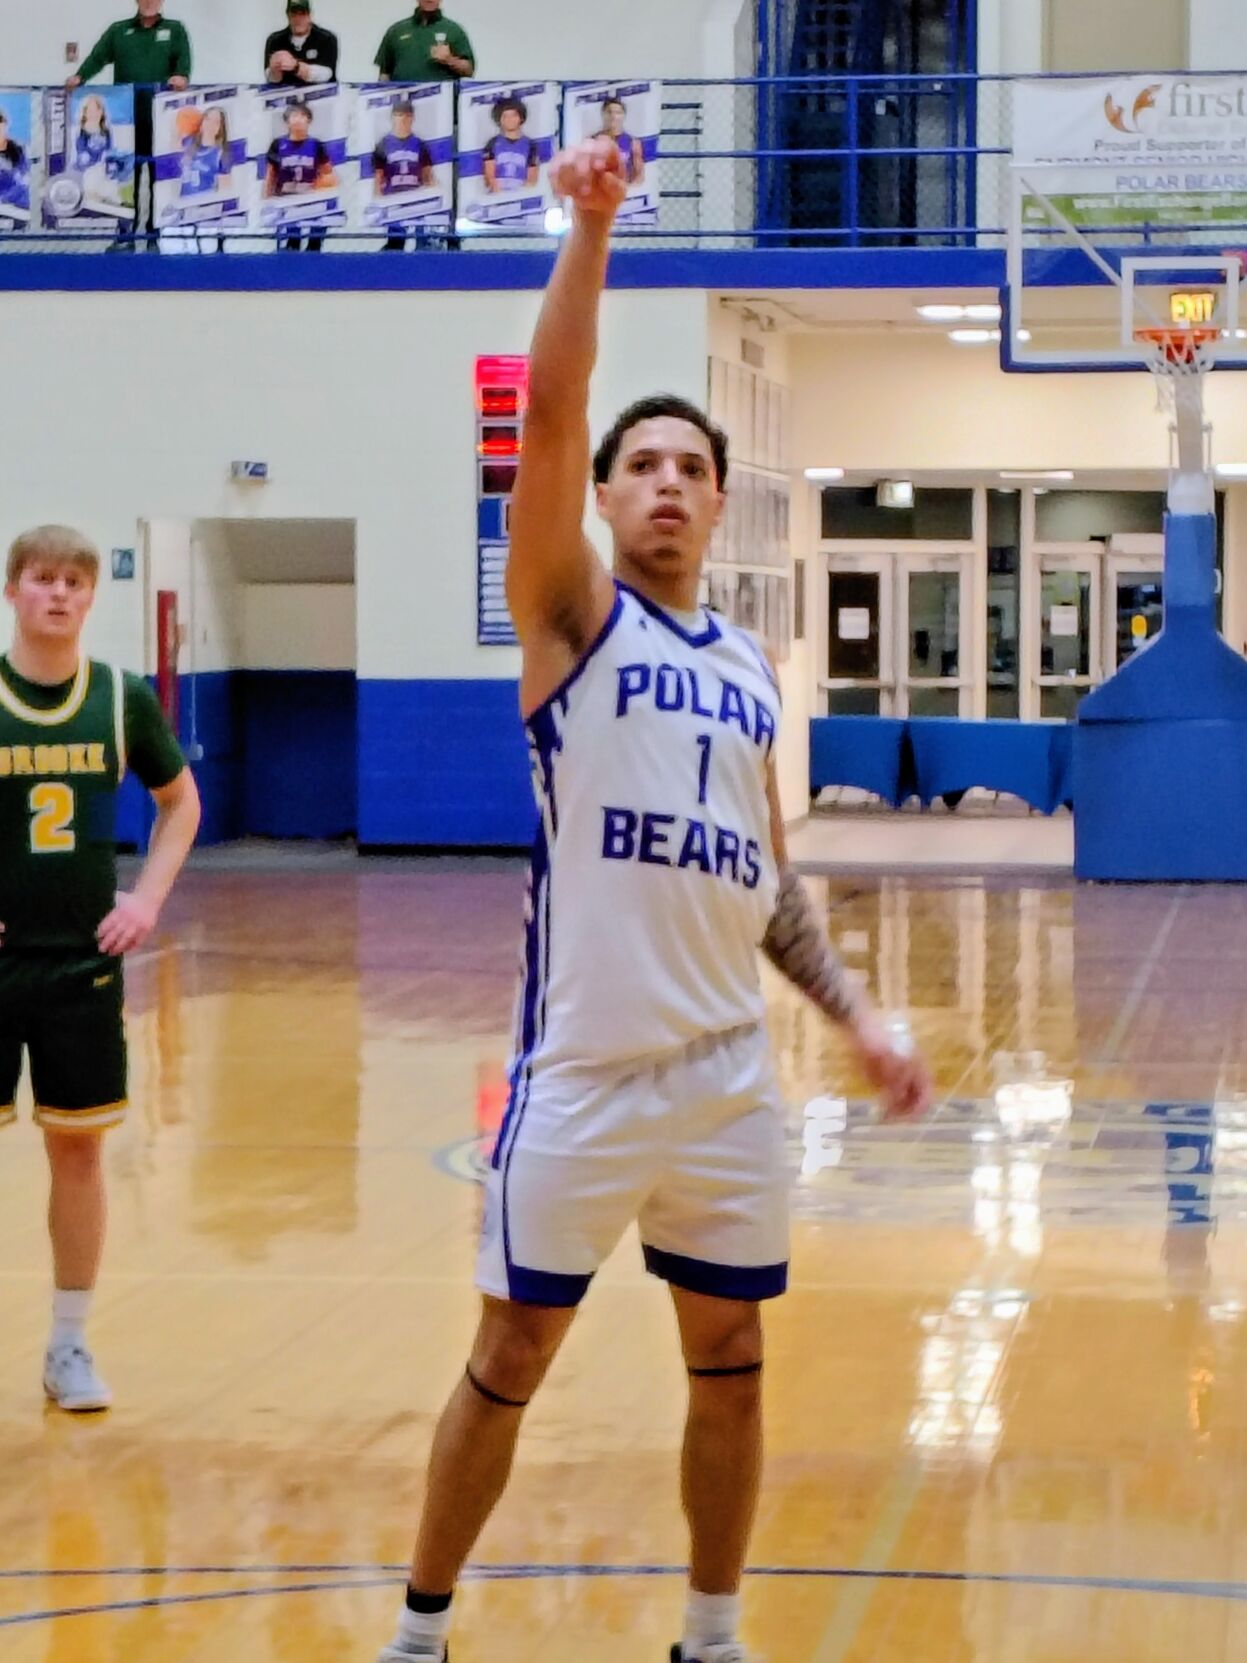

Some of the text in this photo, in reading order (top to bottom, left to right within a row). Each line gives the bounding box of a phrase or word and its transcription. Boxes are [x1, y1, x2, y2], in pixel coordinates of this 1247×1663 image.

[1168, 82, 1247, 117] first
[1095, 139, 1141, 150] Proud
[1147, 138, 1224, 151] Supporter
[1116, 174, 1247, 190] POLAR BEARS
[1171, 293, 1214, 322] EXIT
[616, 662, 775, 751] POLAR
[696, 734, 711, 804] 1
[30, 781, 76, 853] 2
[601, 805, 762, 889] BEARS
